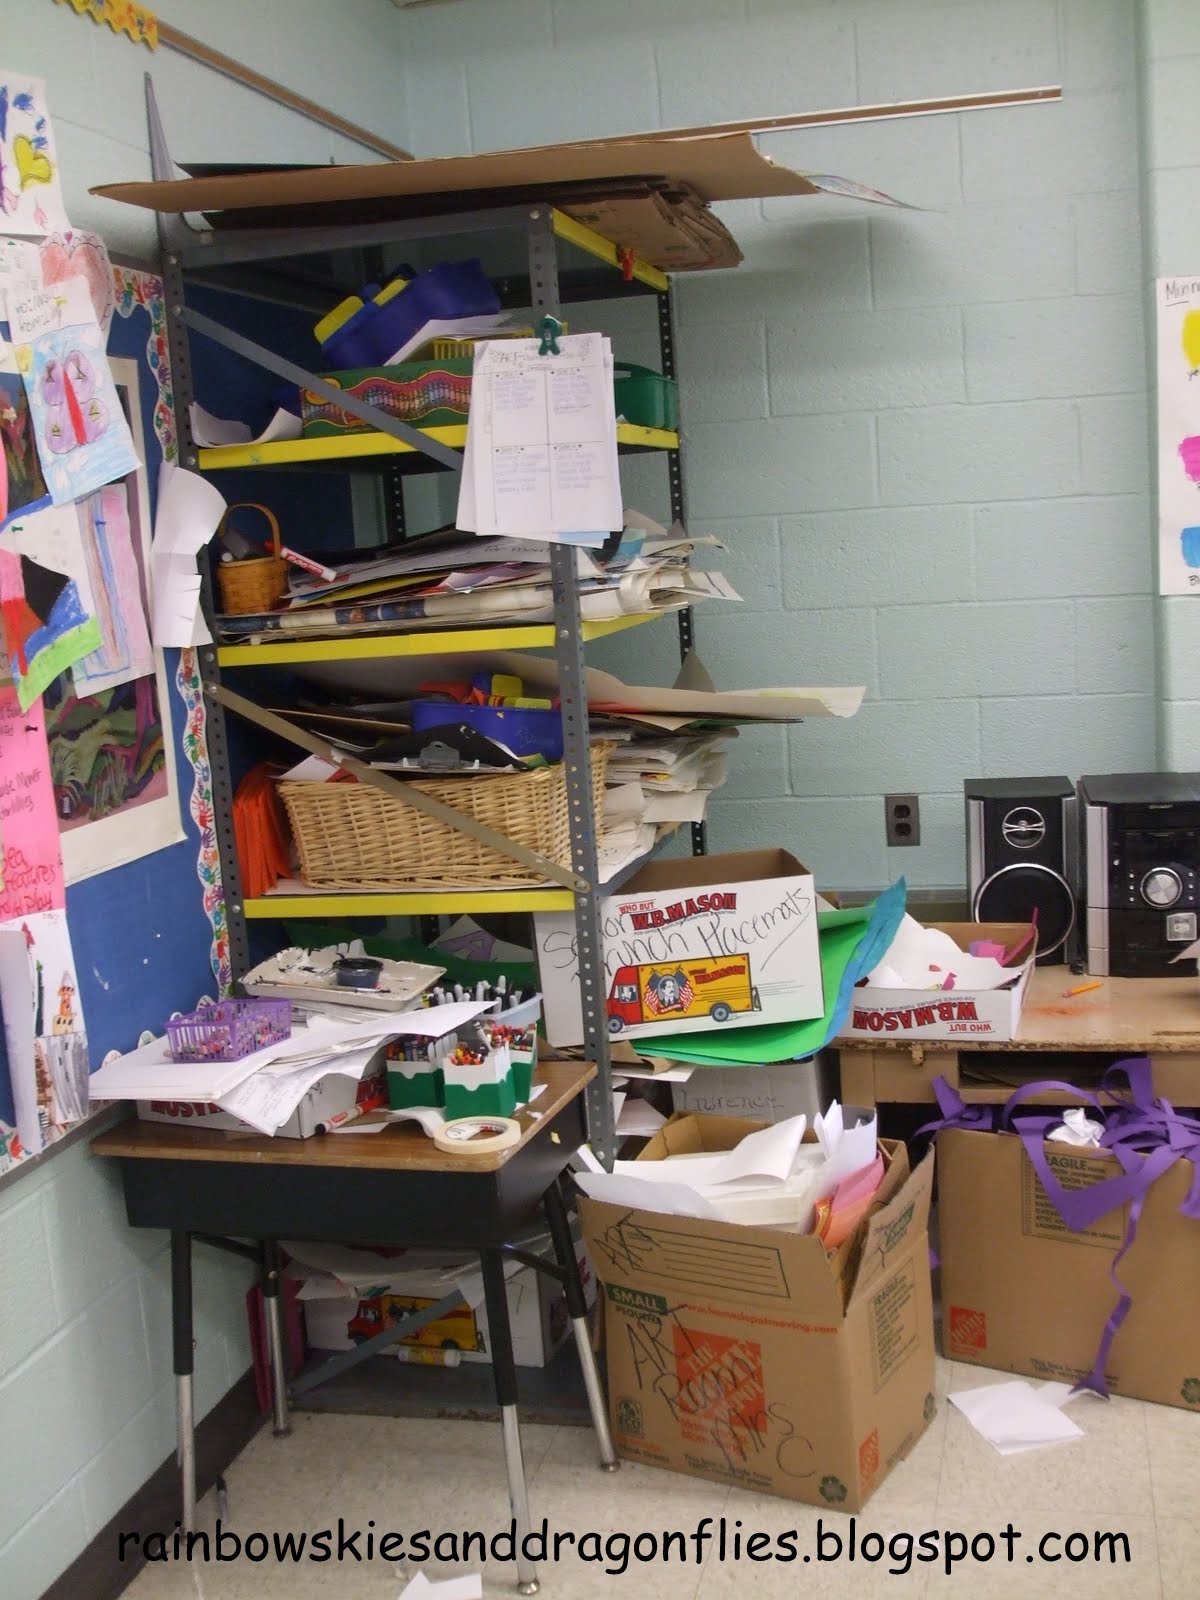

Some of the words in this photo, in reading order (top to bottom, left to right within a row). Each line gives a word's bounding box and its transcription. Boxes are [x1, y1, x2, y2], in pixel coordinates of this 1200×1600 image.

[619, 904, 637, 914] WHO
[639, 901, 656, 912] BUT
[950, 1023, 967, 1032] BUT
[969, 1022, 992, 1033] WHO
[611, 1287, 659, 1311] SMALL
[775, 1434, 817, 1478] C
